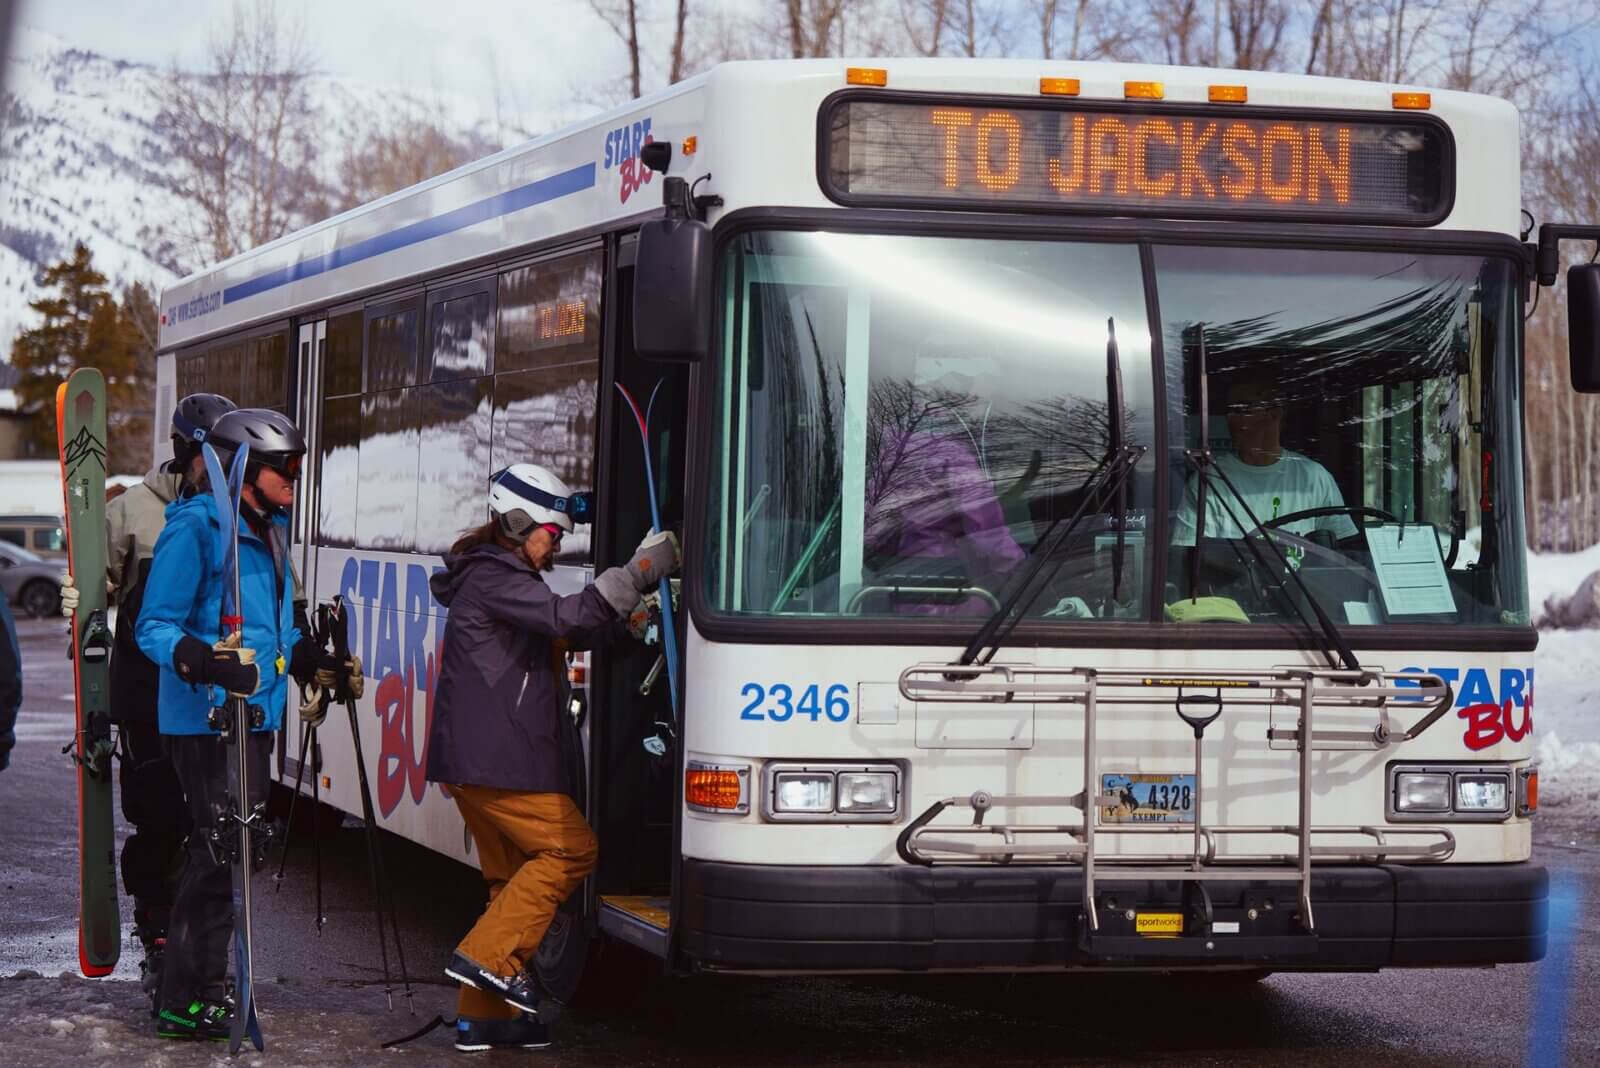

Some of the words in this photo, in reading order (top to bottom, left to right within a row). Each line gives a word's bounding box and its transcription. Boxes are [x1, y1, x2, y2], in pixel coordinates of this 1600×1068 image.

[604, 117, 652, 170] START
[933, 110, 1022, 191] TO
[1048, 116, 1352, 204] JACKSON
[740, 682, 851, 722] 2346
[1132, 813, 1168, 821] EXEMPT
[1149, 784, 1191, 810] 4328
